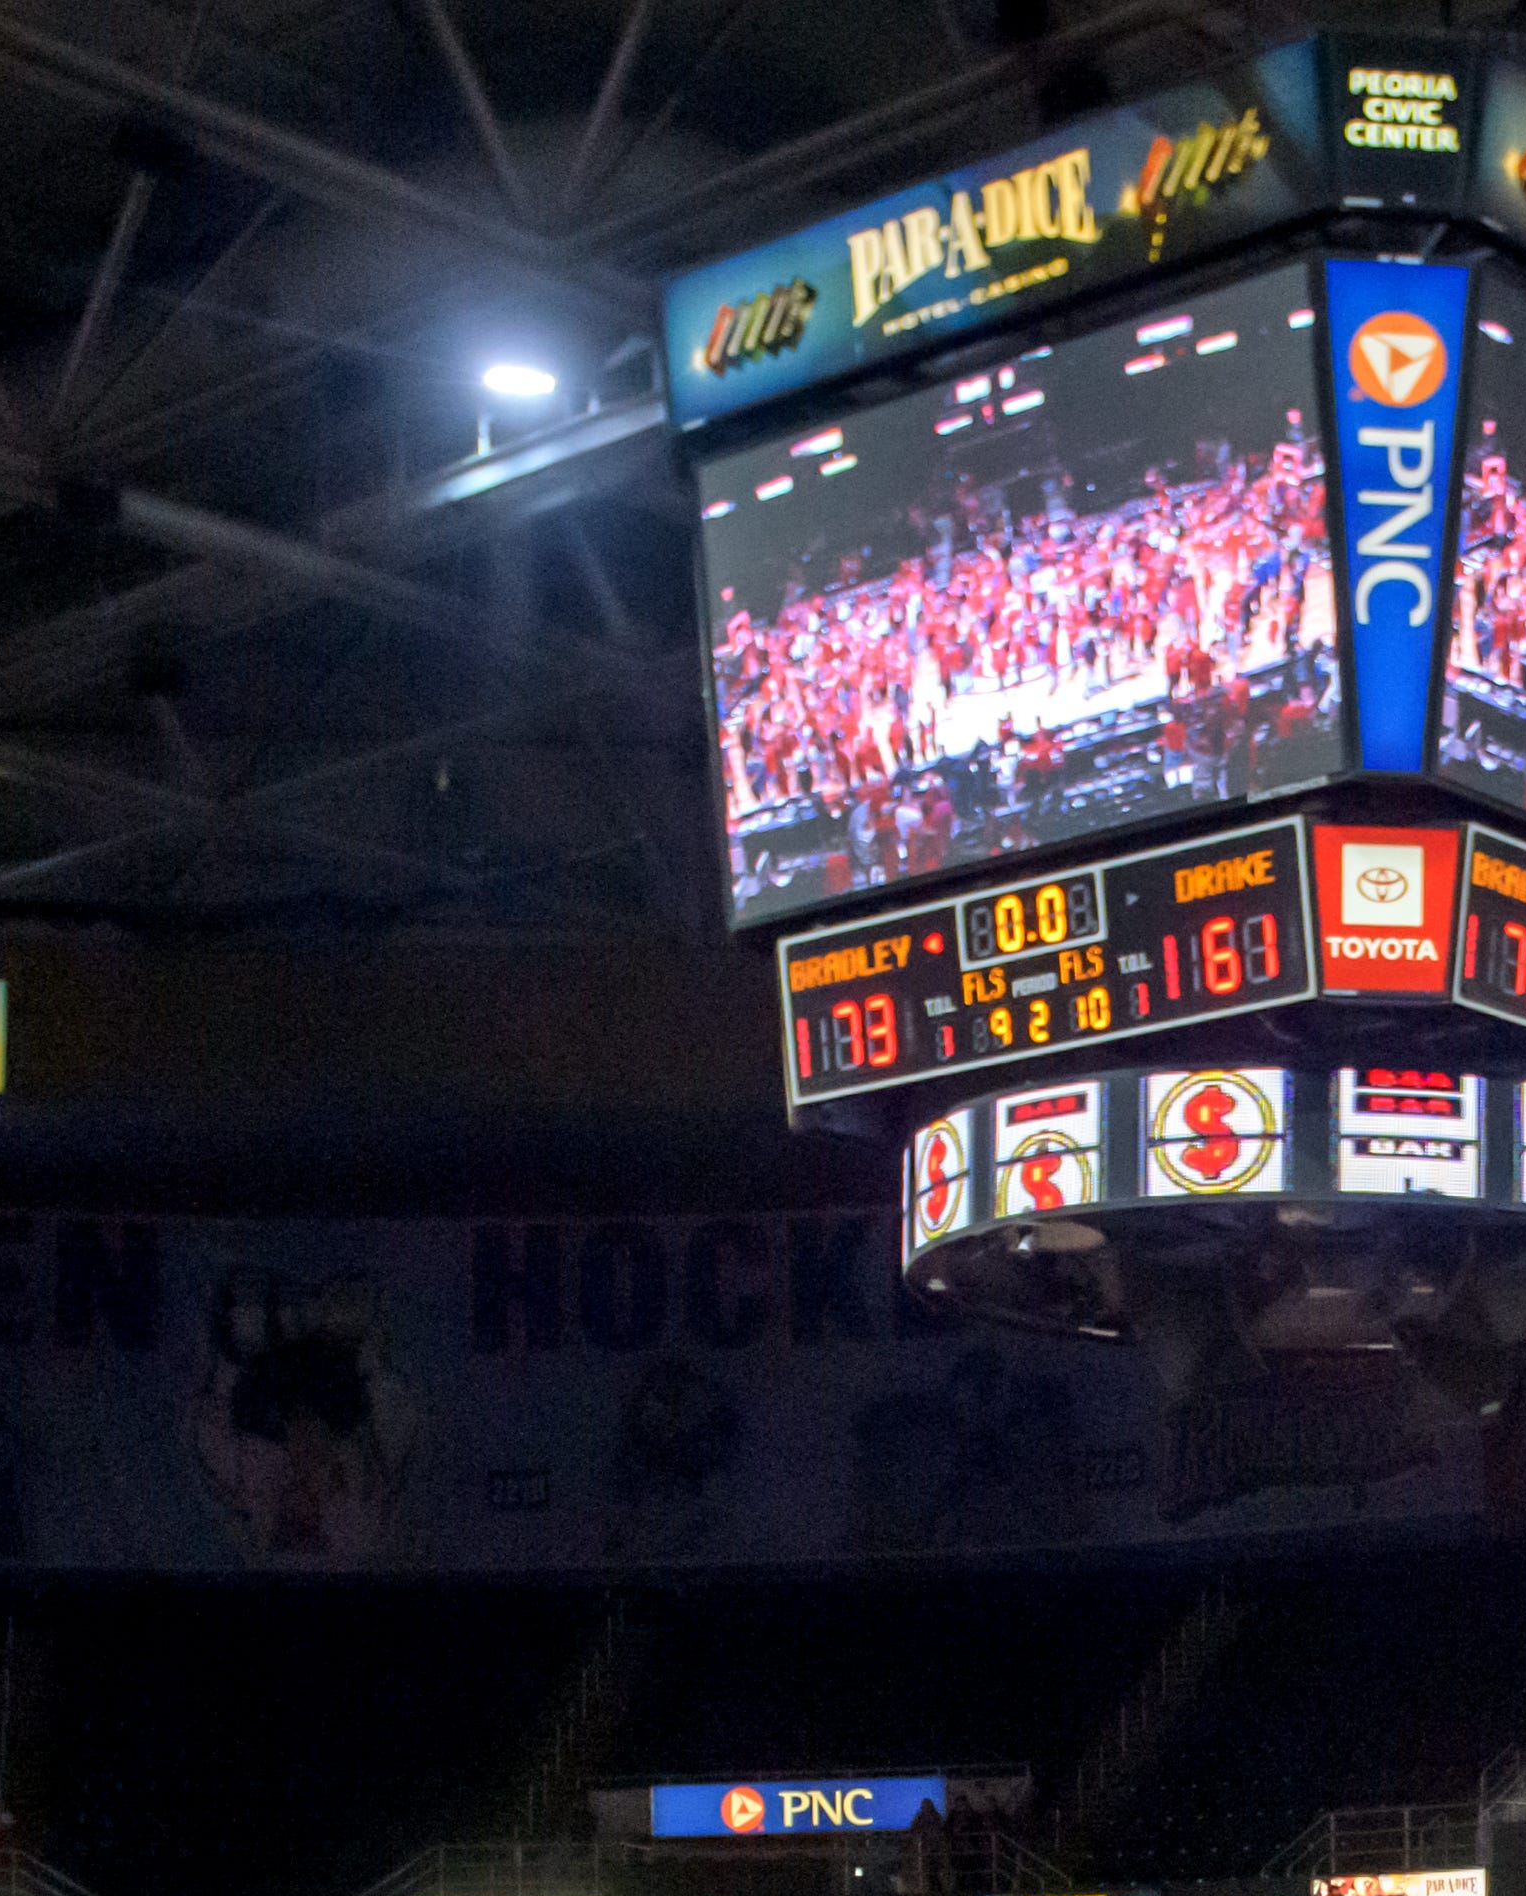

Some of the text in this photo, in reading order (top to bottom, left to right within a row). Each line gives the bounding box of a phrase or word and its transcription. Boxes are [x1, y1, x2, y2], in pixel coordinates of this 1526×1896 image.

[1349, 66, 1458, 101] PEORIA
[1362, 96, 1443, 126] CIVIC
[1343, 117, 1461, 153] CENTER
[1355, 420, 1435, 628] PNC
[1174, 849, 1276, 903] DRAKE
[993, 883, 1068, 954] 0.0
[788, 934, 913, 993] BRADLEY
[1200, 913, 1281, 996] 61
[1326, 936, 1438, 962] TOYOTA
[961, 966, 1008, 1006] FLS
[1058, 945, 1105, 985] FLS
[831, 993, 899, 1067] 73
[989, 1006, 1014, 1046] 9
[1028, 998, 1051, 1043] 2
[1076, 985, 1112, 1031] 10
[778, 1788, 873, 1828] PNC
